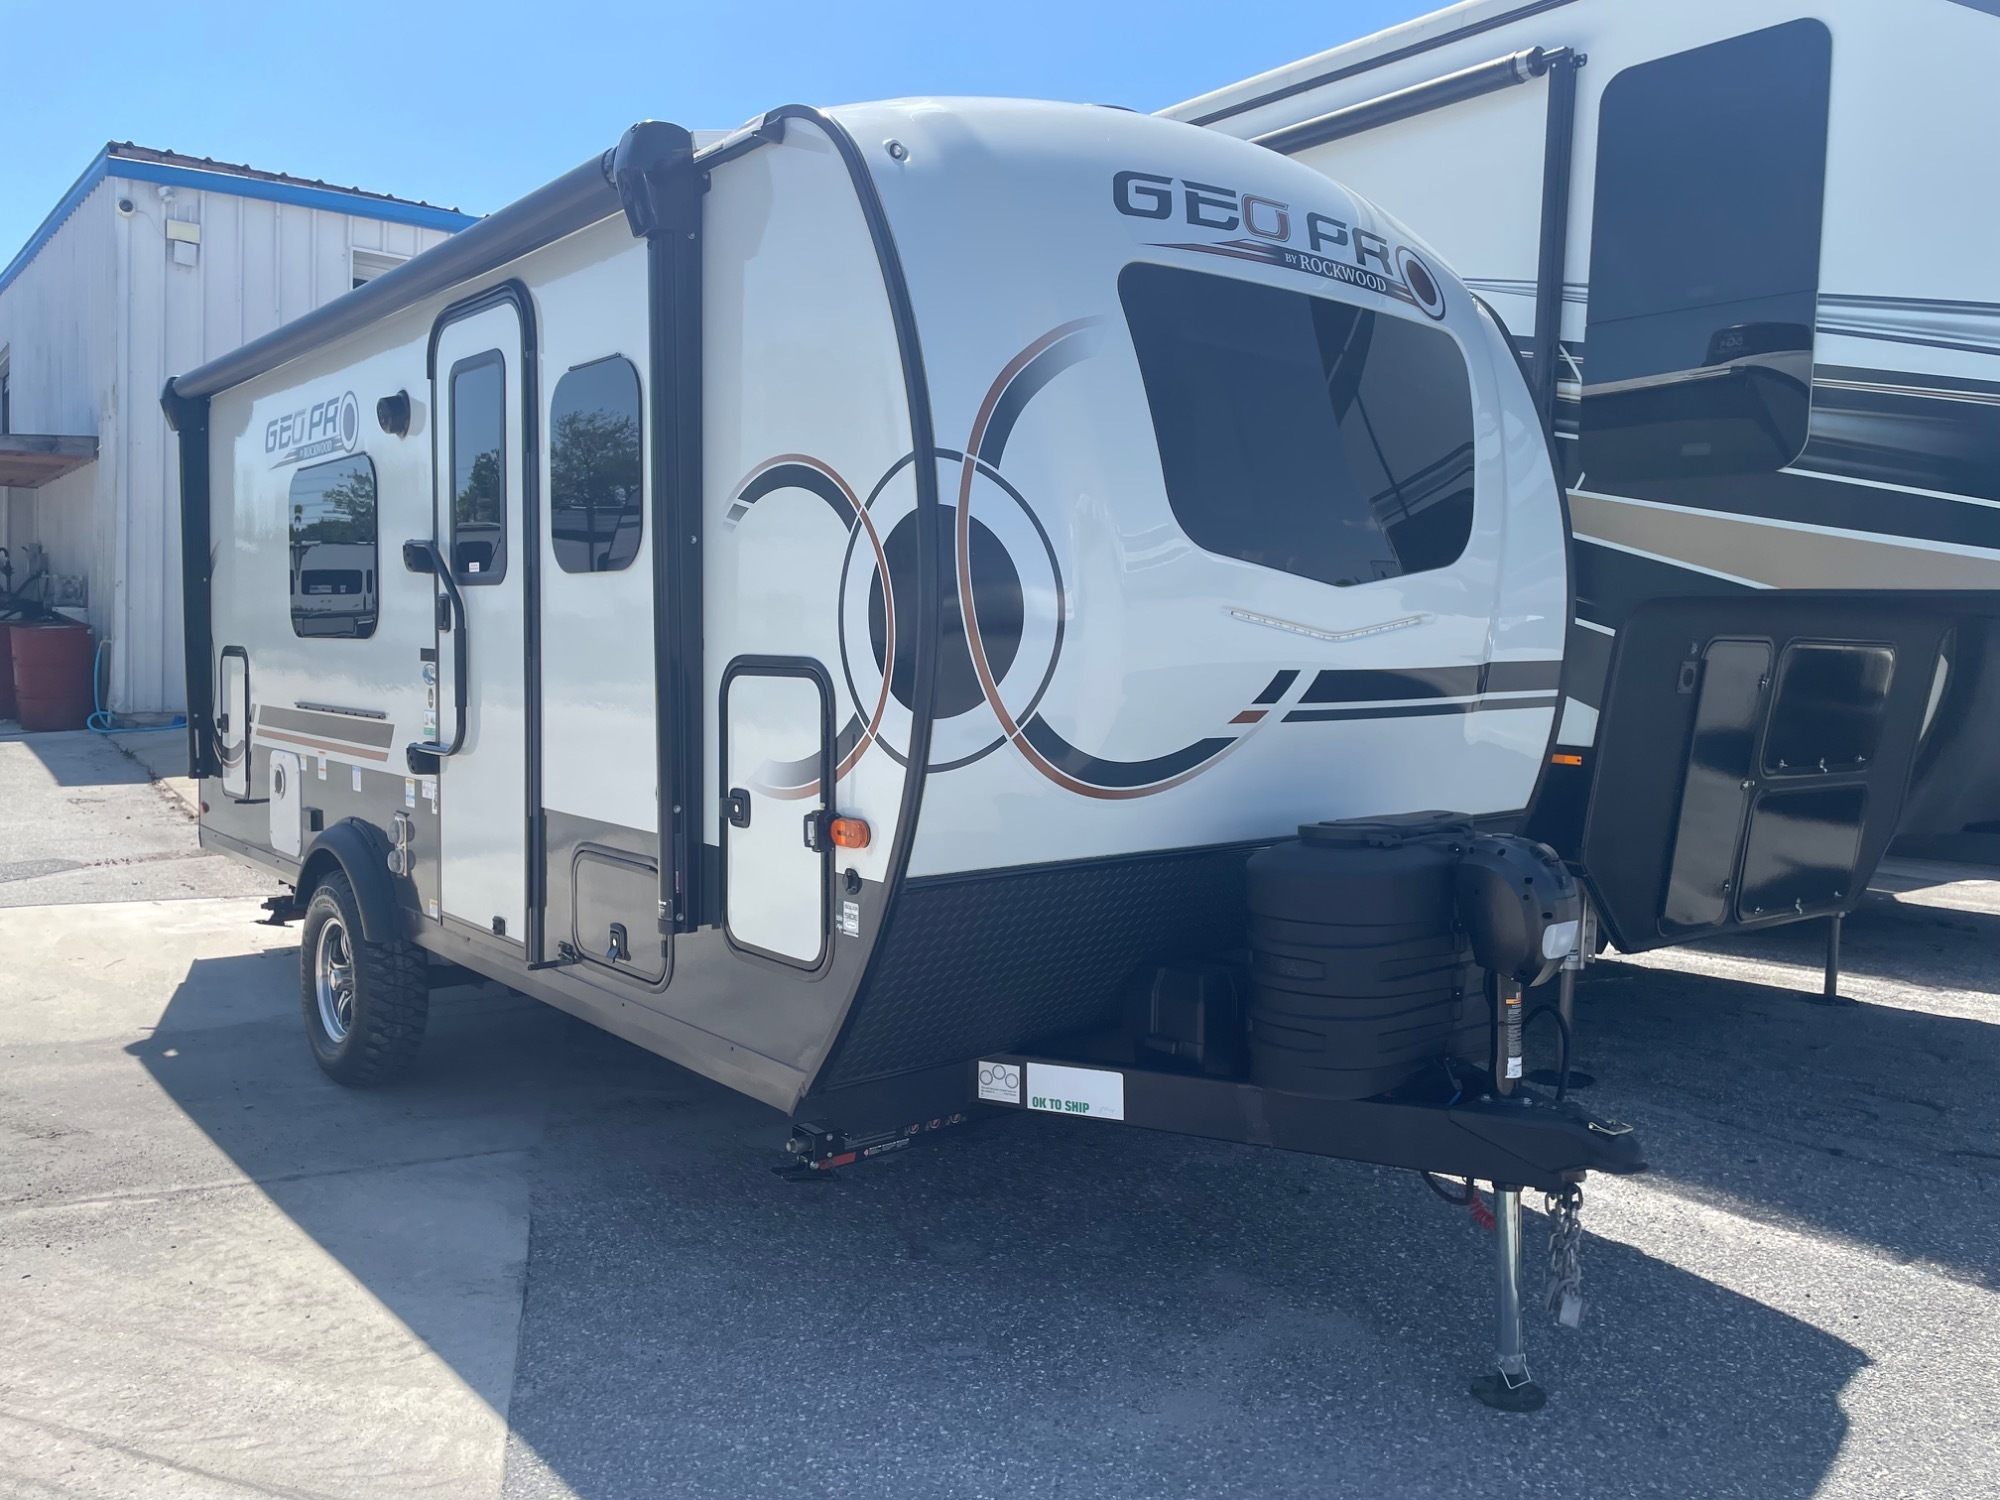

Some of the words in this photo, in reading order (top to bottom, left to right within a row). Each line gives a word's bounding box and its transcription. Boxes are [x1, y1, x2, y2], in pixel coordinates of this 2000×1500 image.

[1113, 170, 1291, 243] GEO
[1306, 211, 1446, 321] PRO
[1285, 253, 1297, 264] BY
[1299, 254, 1387, 292] ROCKWOOD
[265, 409, 307, 453] GEO
[308, 391, 359, 453] PRO
[844, 912, 858, 921] SIDE
[1032, 1096, 1046, 1109] OK
[1049, 1098, 1061, 1110] TO
[1065, 1100, 1090, 1113] SHIP
